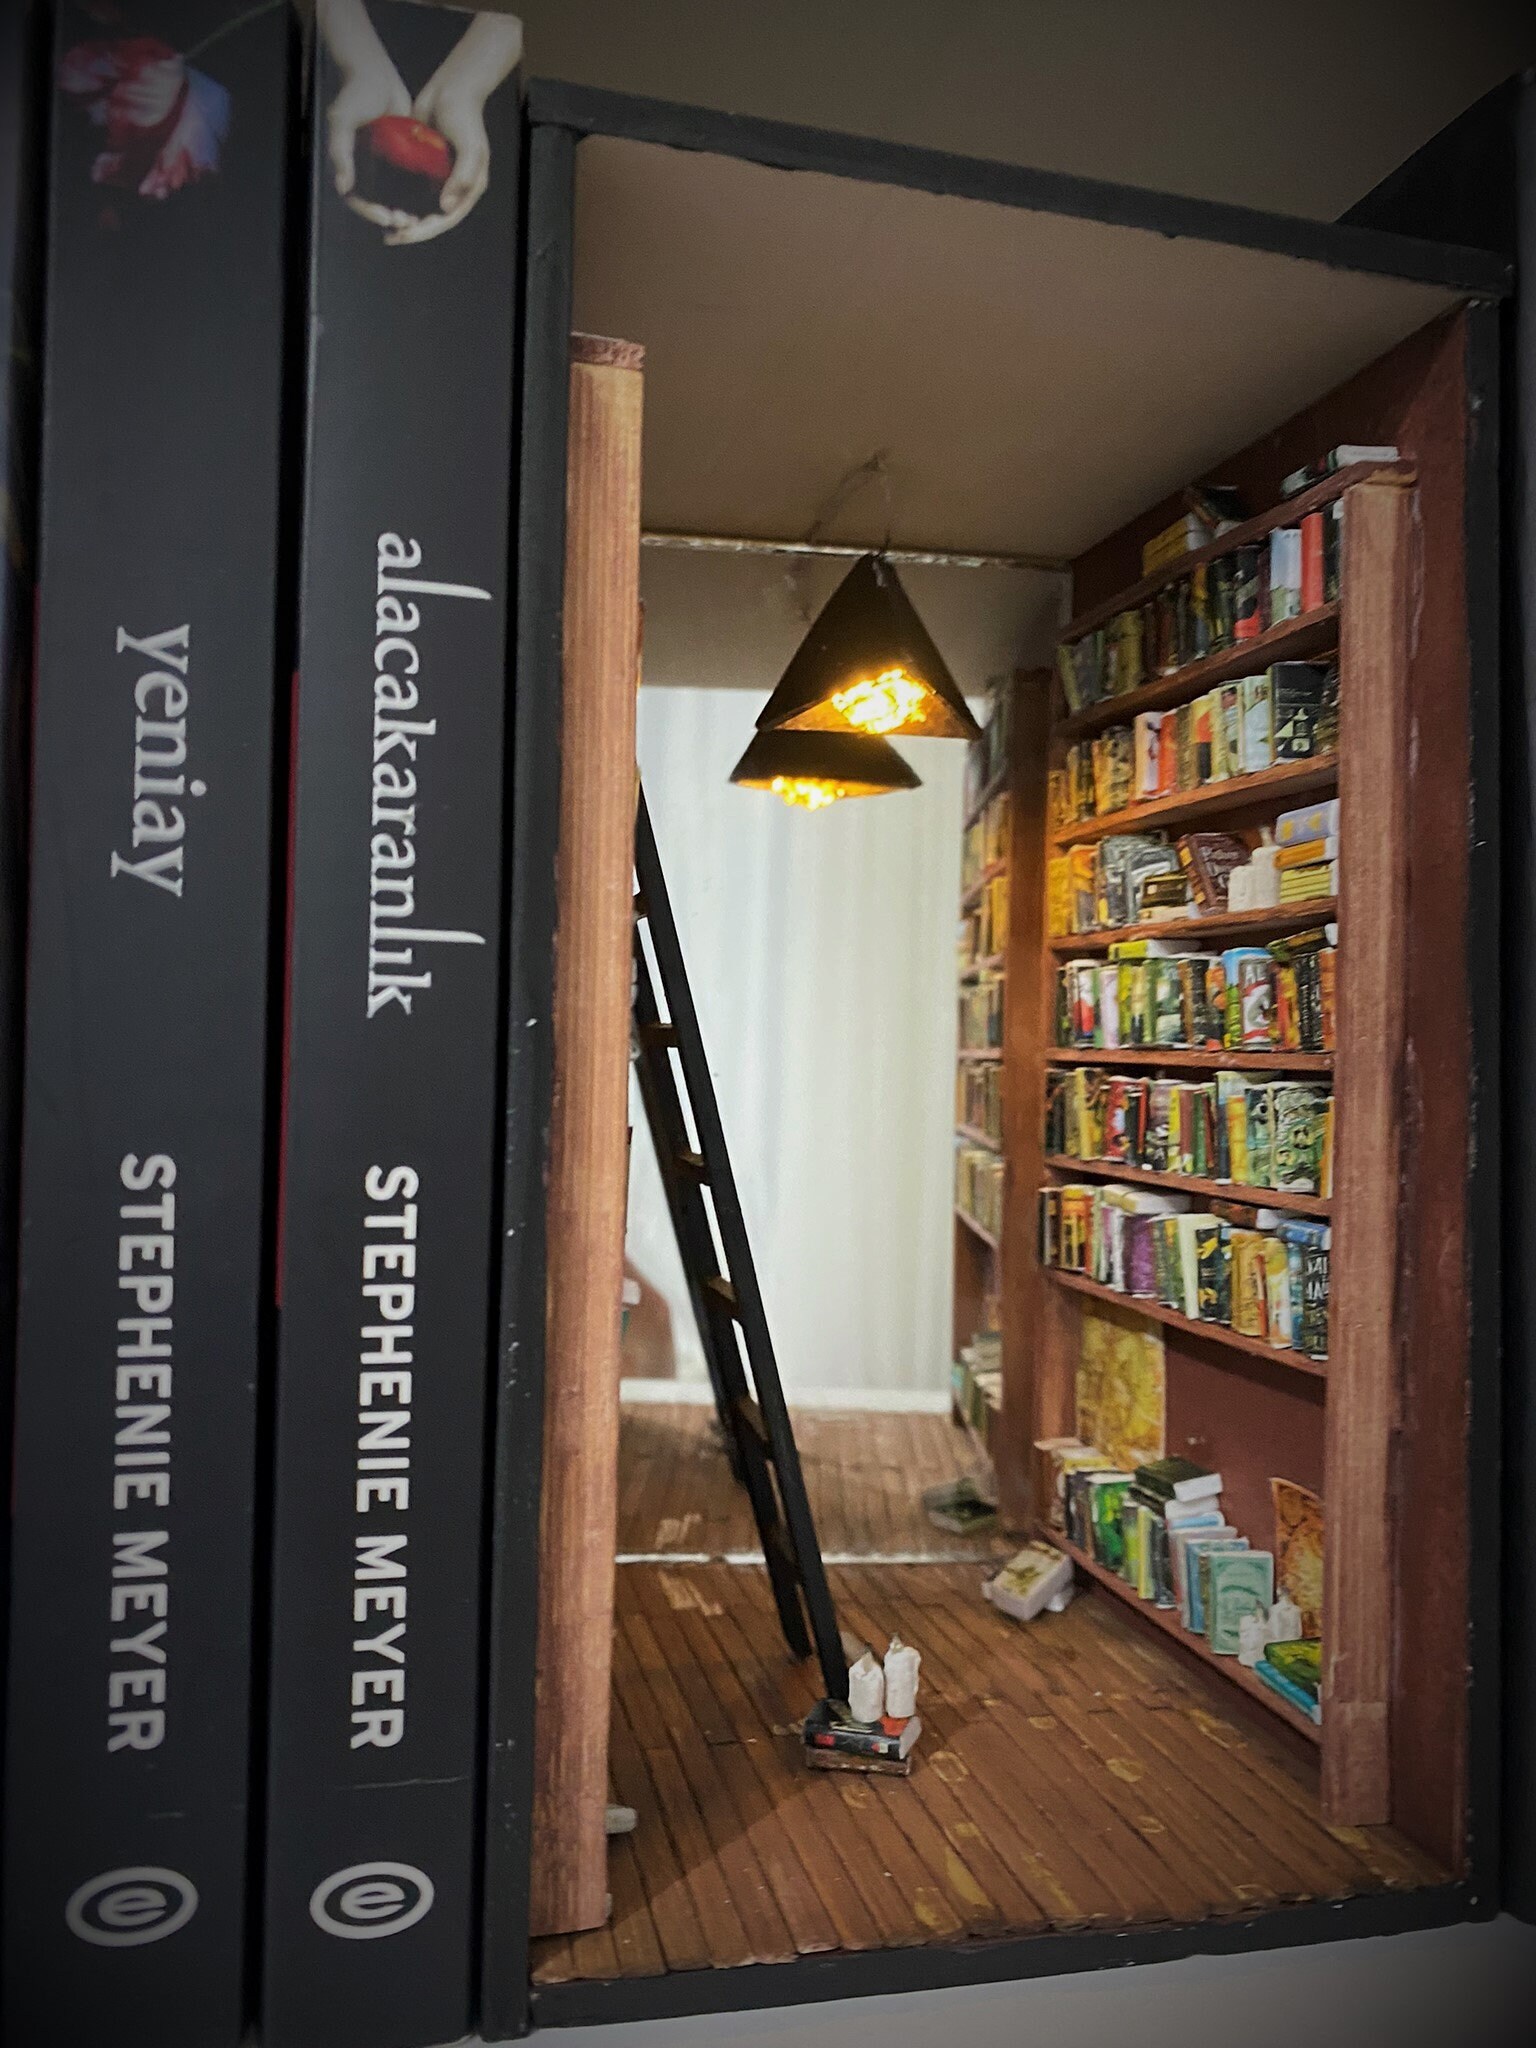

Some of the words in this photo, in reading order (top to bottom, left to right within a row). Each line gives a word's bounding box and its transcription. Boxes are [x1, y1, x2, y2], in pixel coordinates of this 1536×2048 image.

[111, 624, 207, 897] yeniay
[366, 532, 492, 1018] alacakaranlık
[113, 1153, 177, 1510] STEPHENIE
[356, 1165, 419, 1513] STEPHENIE
[106, 1530, 170, 1752] MEYER
[350, 1534, 408, 1749] MEYER
